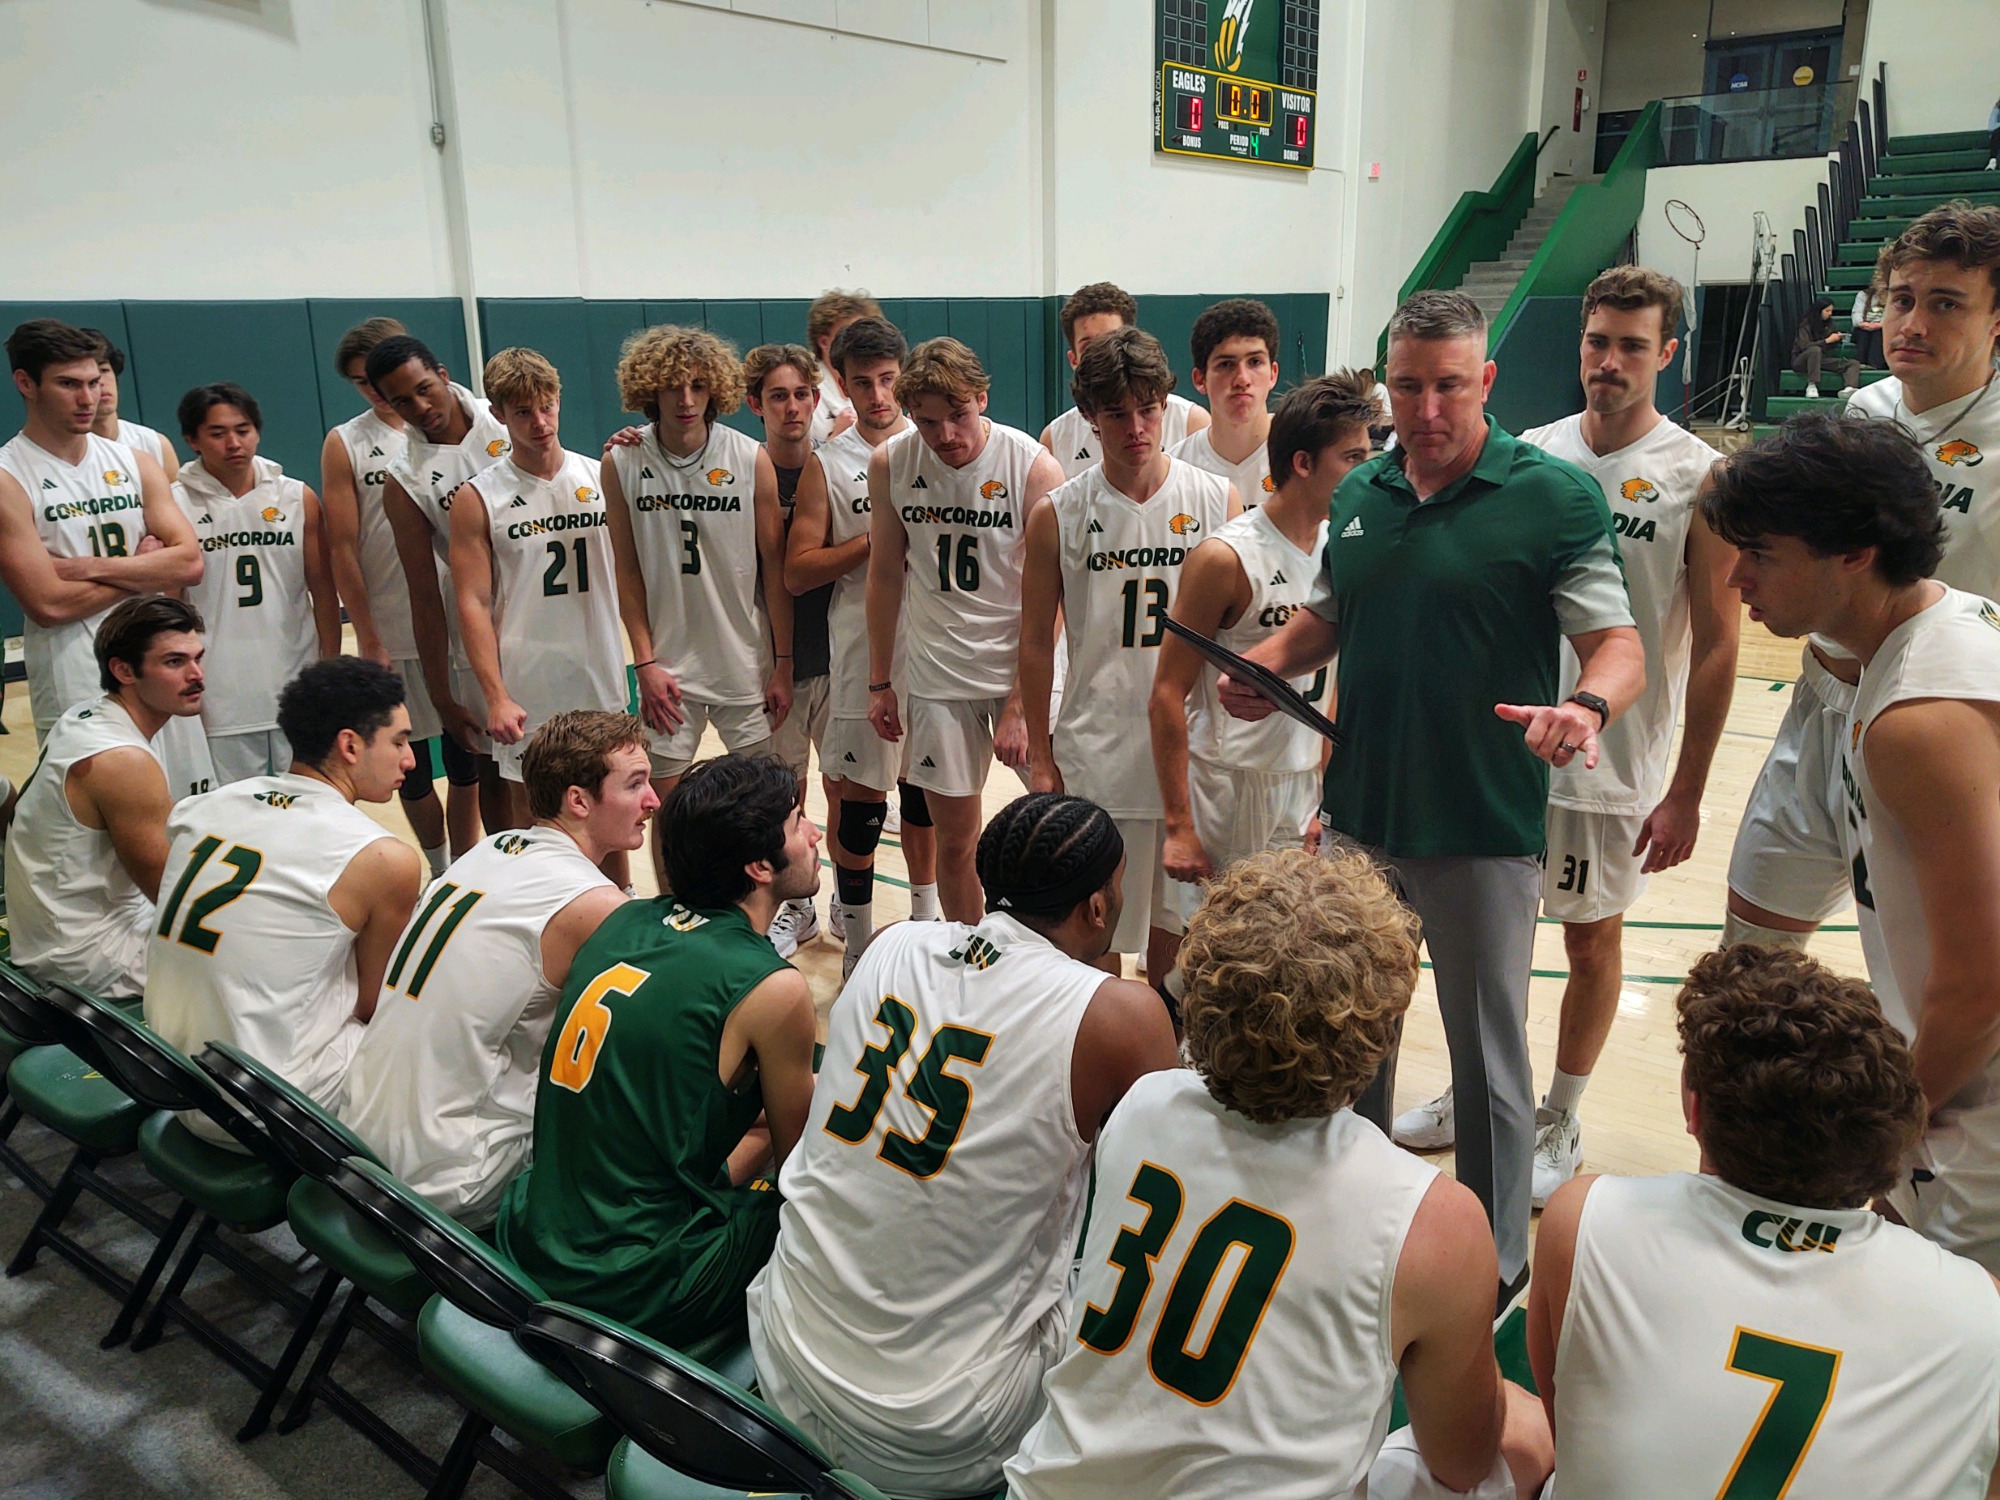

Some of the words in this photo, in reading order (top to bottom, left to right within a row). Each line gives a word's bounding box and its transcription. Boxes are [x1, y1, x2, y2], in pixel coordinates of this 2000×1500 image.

[1172, 70, 1206, 93] EAGLES
[1281, 92, 1311, 113] VISITOR
[1154, 70, 1162, 137] FAIR-PLAY.COM
[1191, 97, 1202, 132] 0
[1182, 135, 1202, 148] BONUS
[1229, 133, 1249, 147] PERIOD
[1250, 134, 1259, 156] 4
[1297, 116, 1308, 147] 0
[1283, 149, 1299, 161] BONUS
[44, 494, 143, 522] CONCORDIA
[636, 494, 742, 512] CONCORDIA
[901, 505, 1013, 528] CONCORDIA
[508, 512, 608, 540] CONCORDIA
[543, 537, 590, 597] 21
[680, 520, 701, 575] 3
[935, 533, 981, 593] 16
[236, 554, 263, 608] 9
[1120, 577, 1170, 649] 13
[157, 833, 264, 956] 12
[1557, 854, 1590, 896] 31
[385, 880, 486, 1001] 11
[549, 961, 652, 1094] 6
[822, 993, 997, 1182] 35
[1076, 1159, 1297, 1408] 30
[1714, 1324, 1844, 1500] 7
